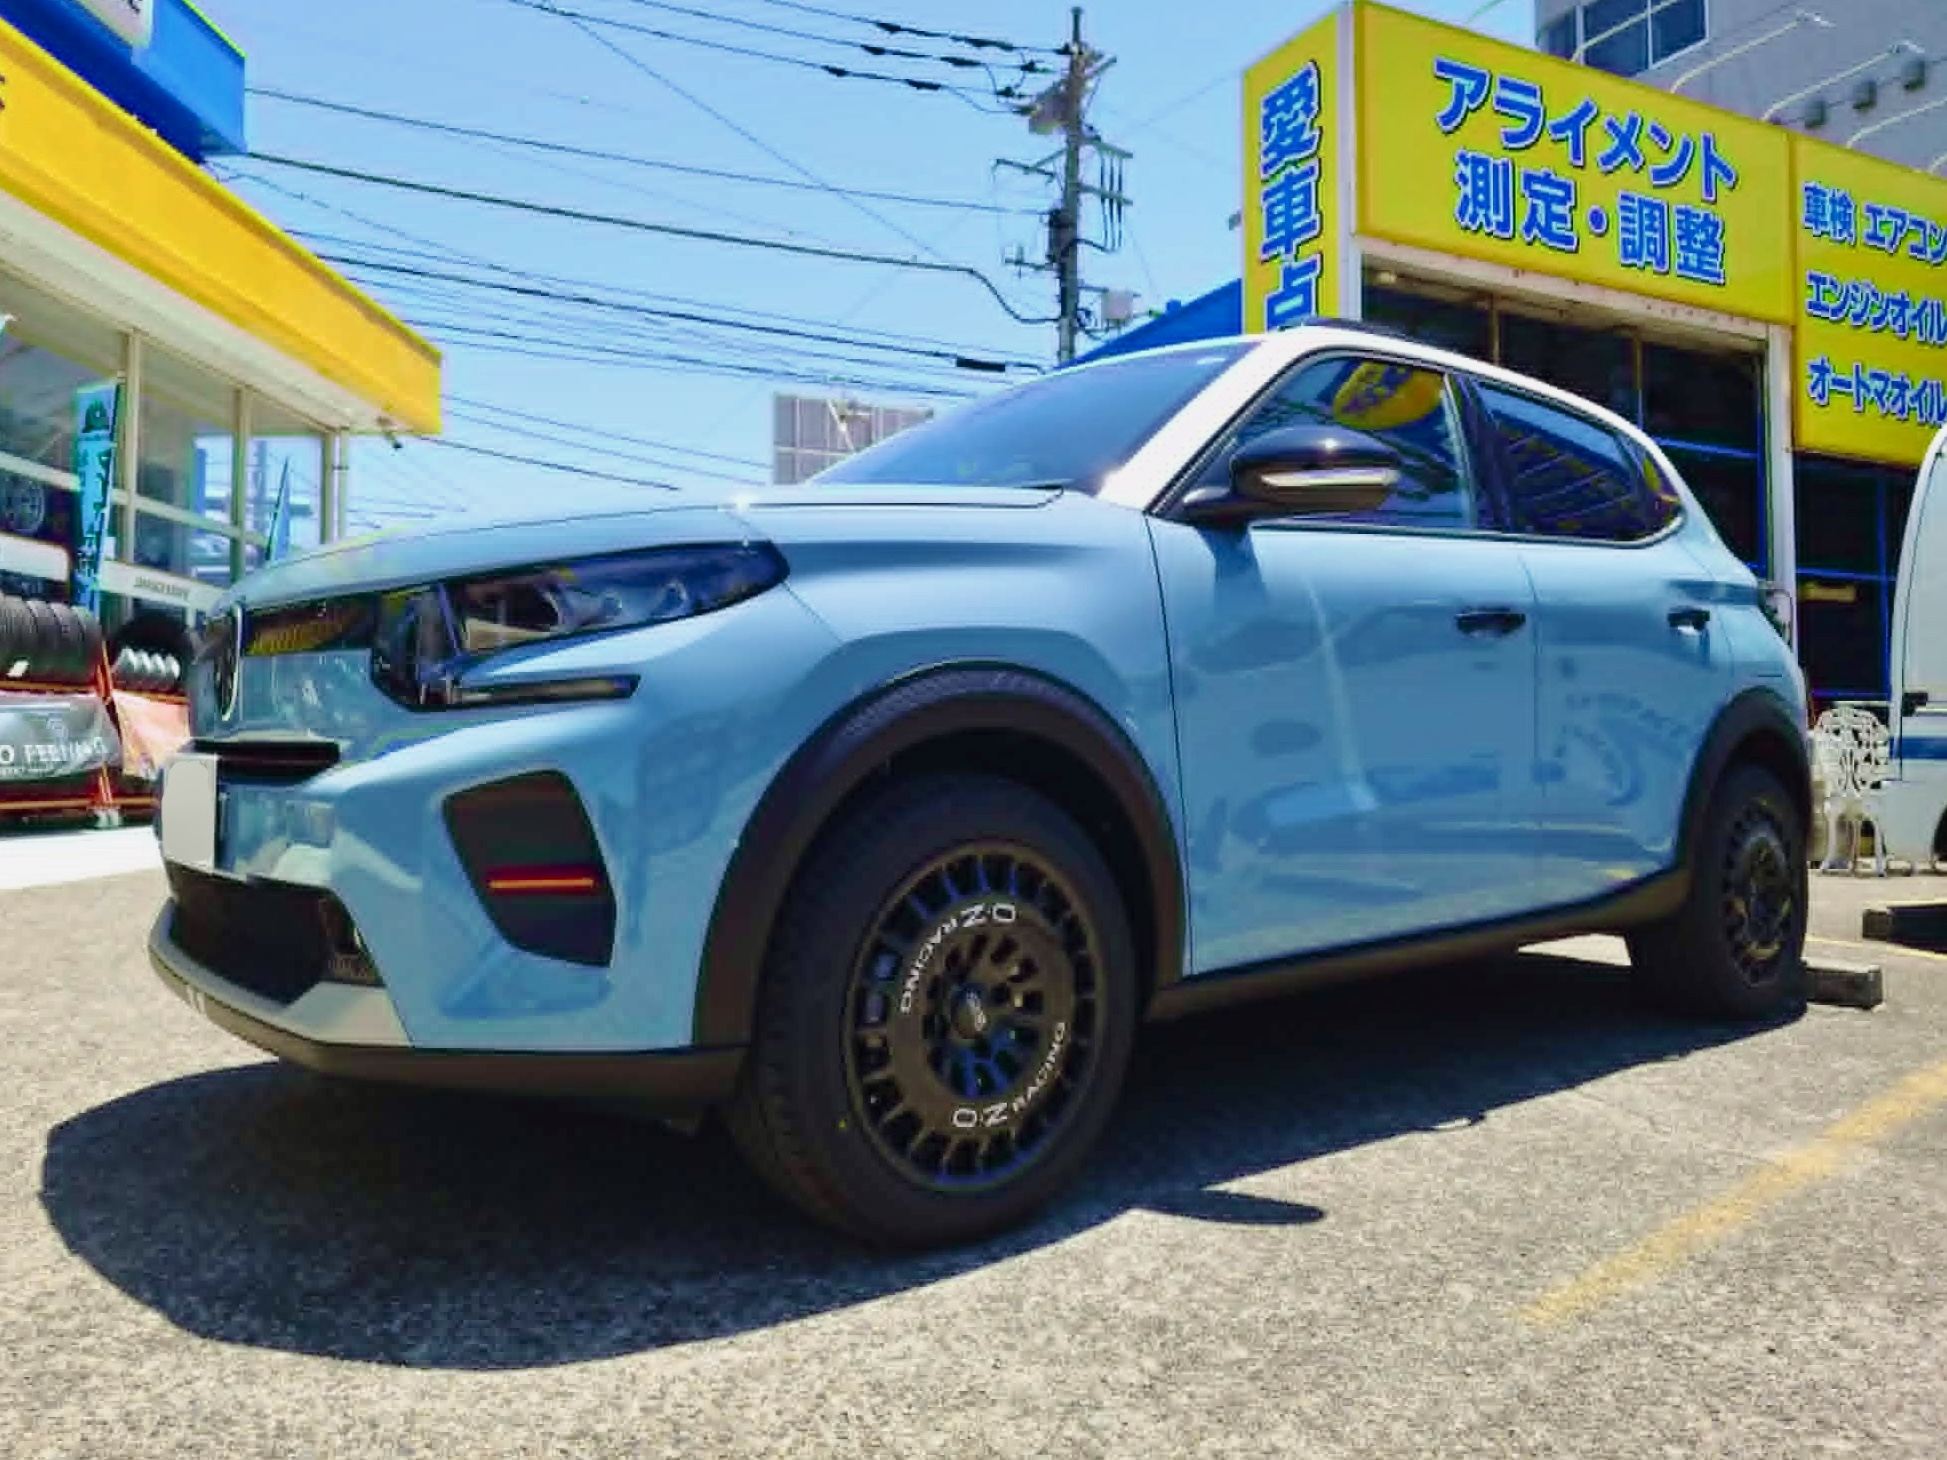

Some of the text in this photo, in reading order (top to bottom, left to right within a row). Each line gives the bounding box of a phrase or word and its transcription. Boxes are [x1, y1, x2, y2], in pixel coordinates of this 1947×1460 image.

[1434, 57, 1737, 202] アライメント
[1454, 147, 1726, 285] 測定・調整
[1802, 181, 1947, 265] 車検 エアコン
[1805, 269, 1947, 345] エンジンオイル
[1806, 355, 1947, 426] オートマオイル
[900, 917, 958, 1015] RACING
[1011, 1021, 1068, 1112] RACING
